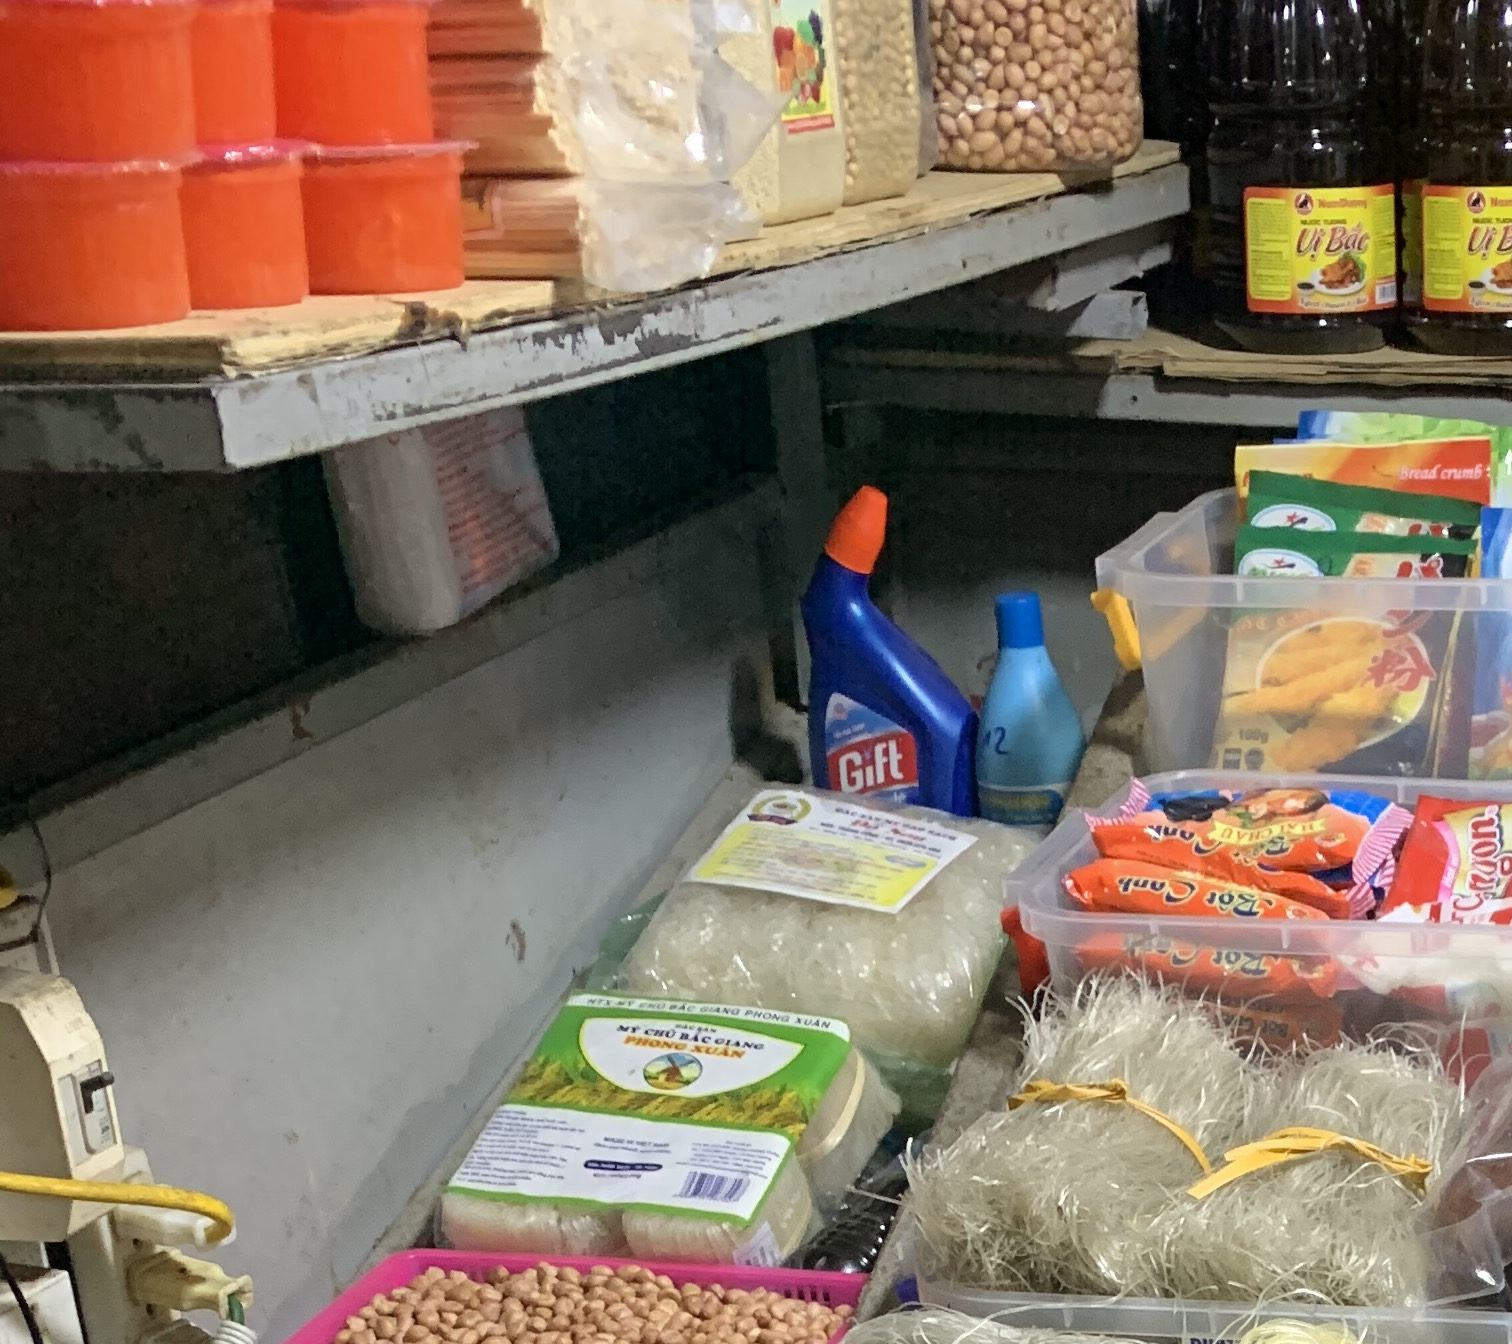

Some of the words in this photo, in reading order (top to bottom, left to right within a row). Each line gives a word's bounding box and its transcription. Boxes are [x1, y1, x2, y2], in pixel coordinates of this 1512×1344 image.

[1399, 464, 1437, 481] Bread
[1440, 464, 1482, 480] crumb
[838, 739, 905, 794] Gift
[1117, 876, 1197, 904] Canh
[623, 1035, 690, 1052] PHONG
[690, 1042, 747, 1061] XUÂN
